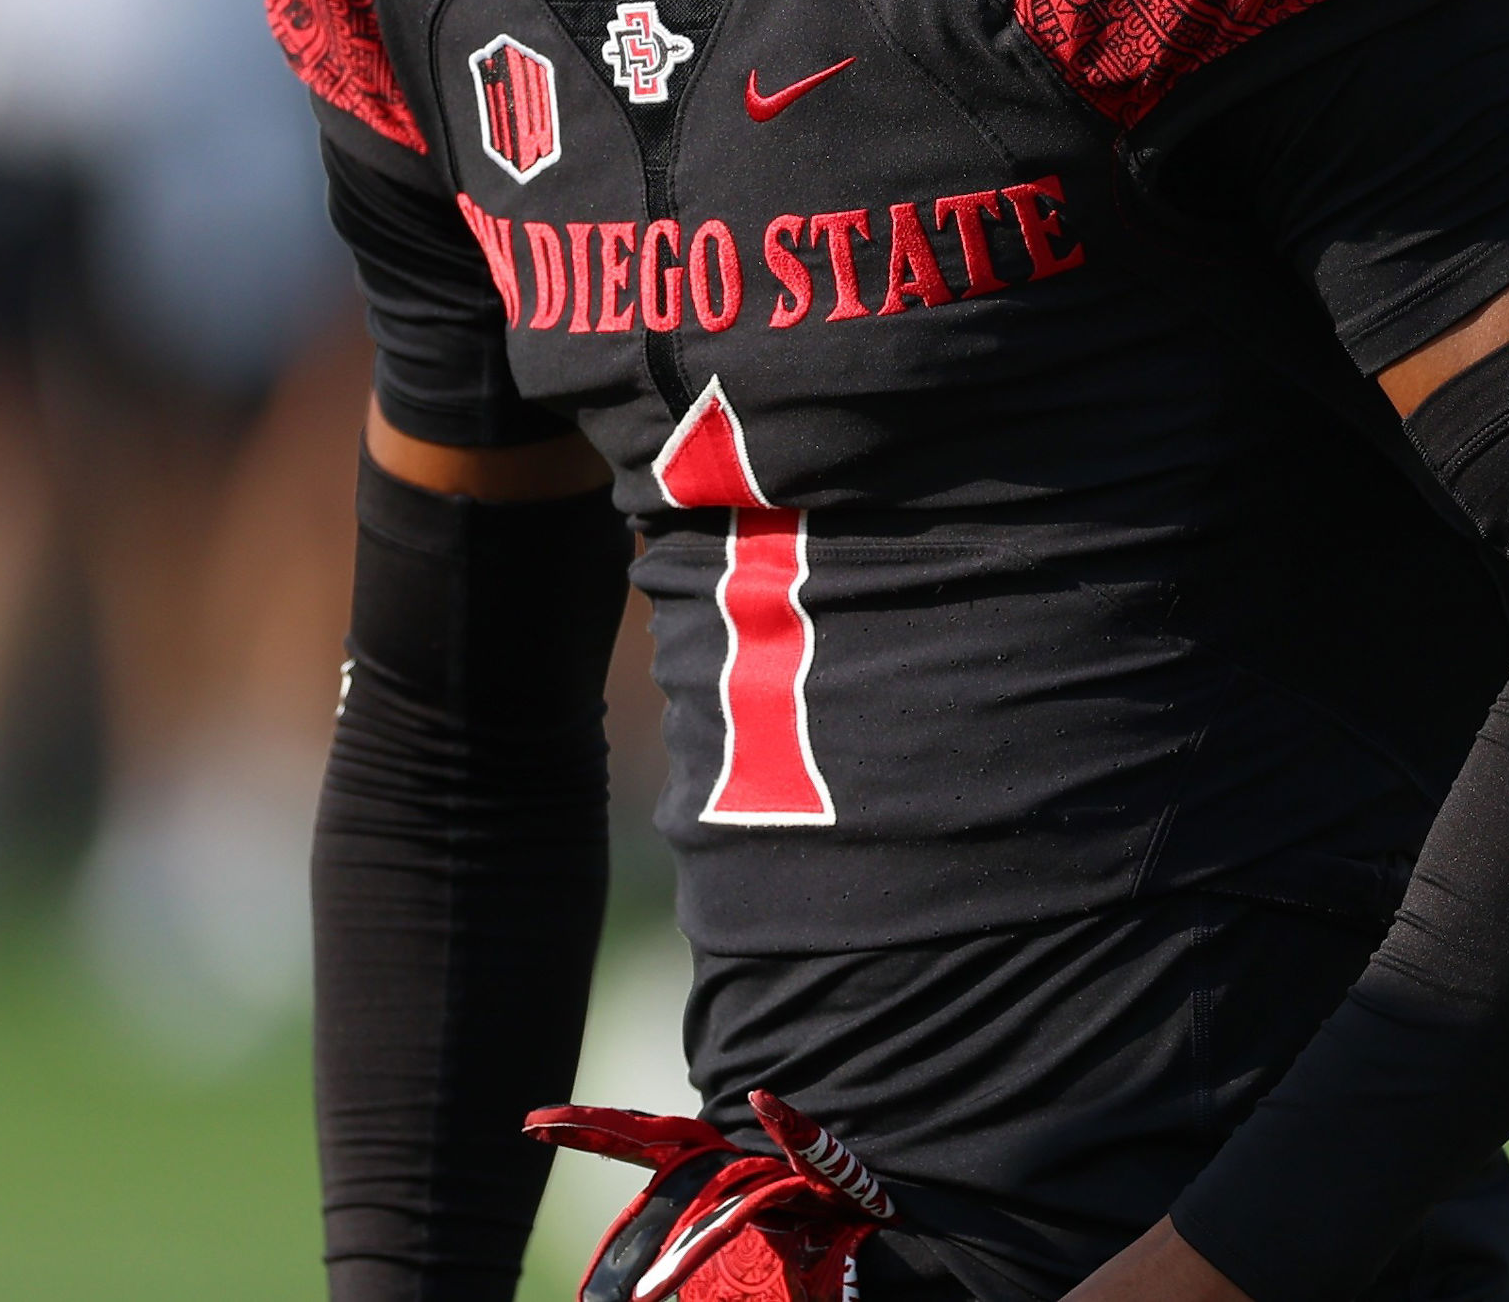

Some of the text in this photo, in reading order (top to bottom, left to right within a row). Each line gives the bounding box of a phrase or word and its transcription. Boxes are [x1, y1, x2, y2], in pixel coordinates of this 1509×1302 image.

[523, 217, 744, 334] DIEGO
[763, 175, 1086, 329] STATE
[651, 373, 837, 827] 1
